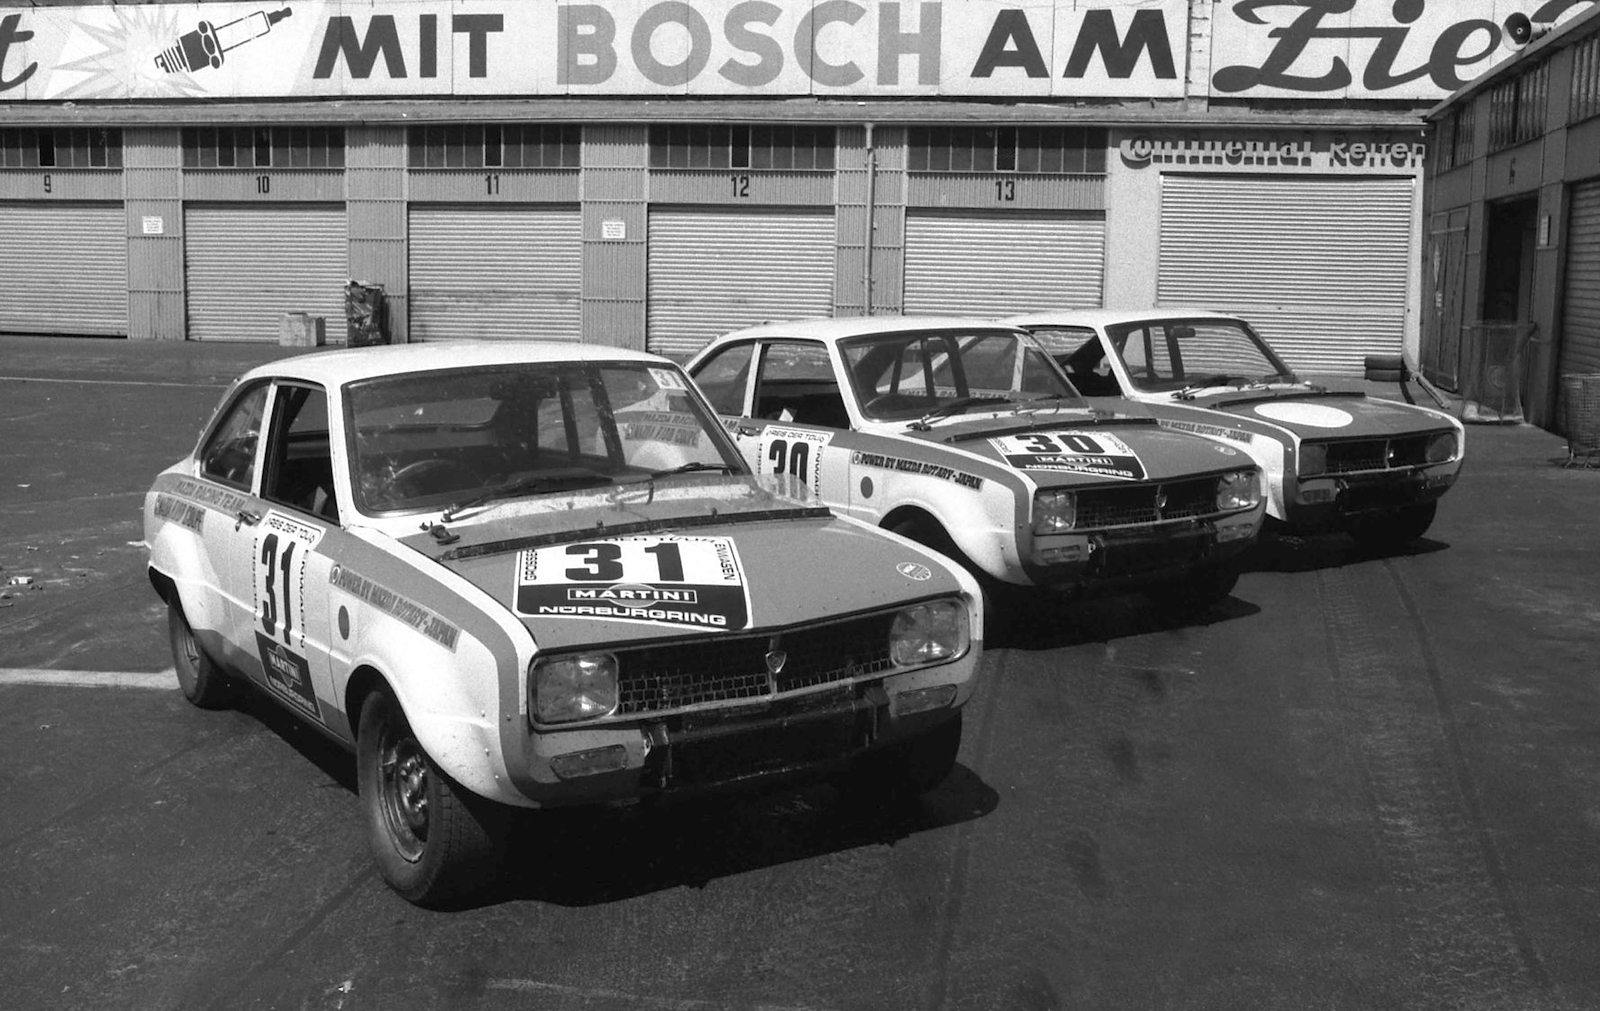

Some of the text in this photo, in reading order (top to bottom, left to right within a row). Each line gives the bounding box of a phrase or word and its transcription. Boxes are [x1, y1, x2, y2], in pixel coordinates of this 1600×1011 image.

[313, 0, 1177, 86] MIT BOSCH AM
[1212, 0, 1598, 93] Zie
[43, 175, 52, 194] 9
[256, 175, 270, 194] 10
[484, 174, 499, 195] 11
[731, 176, 749, 198] 12
[995, 180, 1015, 202] 13
[1014, 434, 1105, 453] 30
[861, 453, 885, 467] POWER
[884, 457, 897, 469] BY
[1040, 456, 1111, 465] MARTINI
[565, 542, 685, 582] 31
[262, 533, 297, 646] 31
[575, 590, 690, 601] MARTINI
